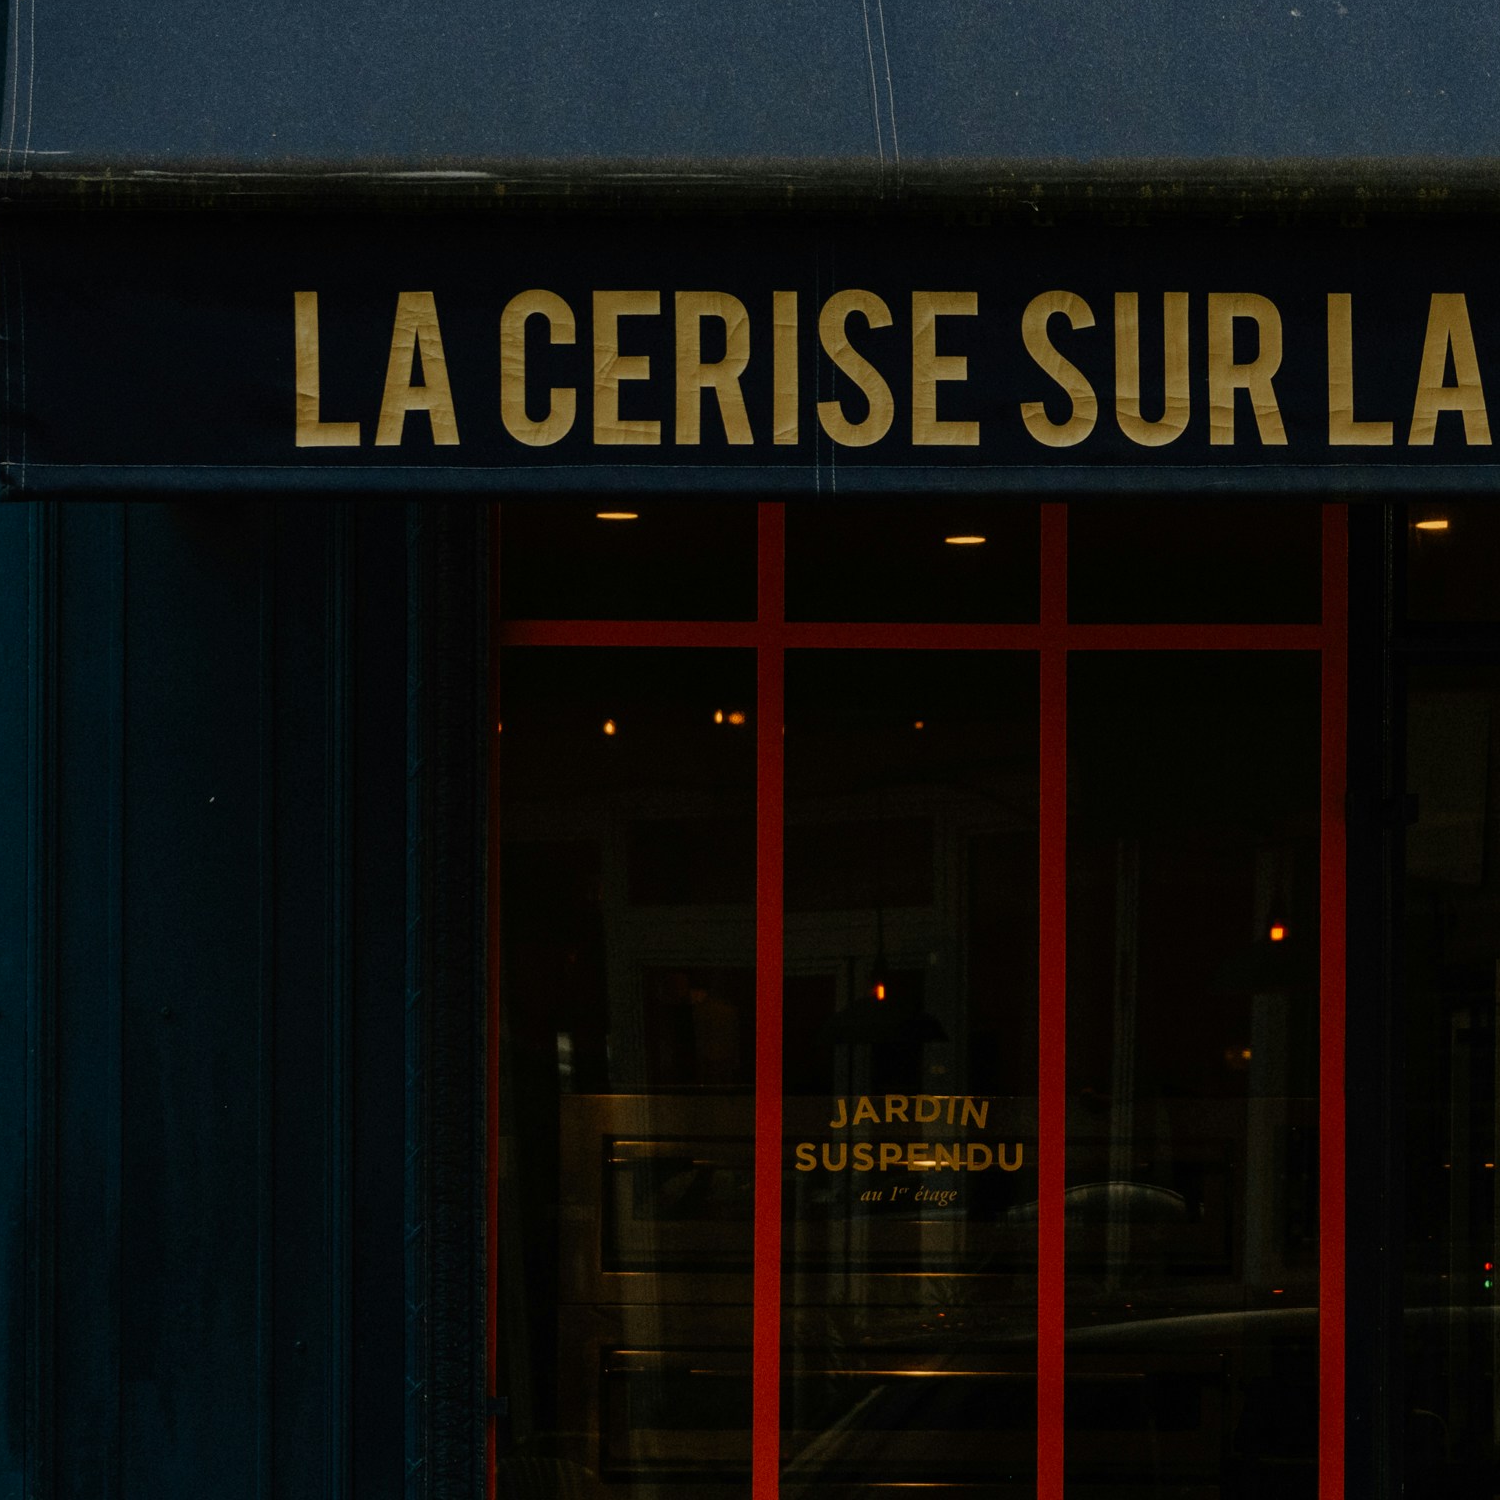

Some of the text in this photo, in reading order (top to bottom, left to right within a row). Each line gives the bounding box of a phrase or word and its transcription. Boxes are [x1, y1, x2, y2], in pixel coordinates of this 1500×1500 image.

[294, 291, 459, 446] LA
[500, 289, 980, 446] CERISE
[1020, 290, 1288, 446] SUR
[1327, 292, 1492, 446] LA
[829, 1094, 989, 1129] JARDIN
[794, 1142, 1024, 1172] SUSPENDU
[860, 1185, 958, 1207] au 1er étage
